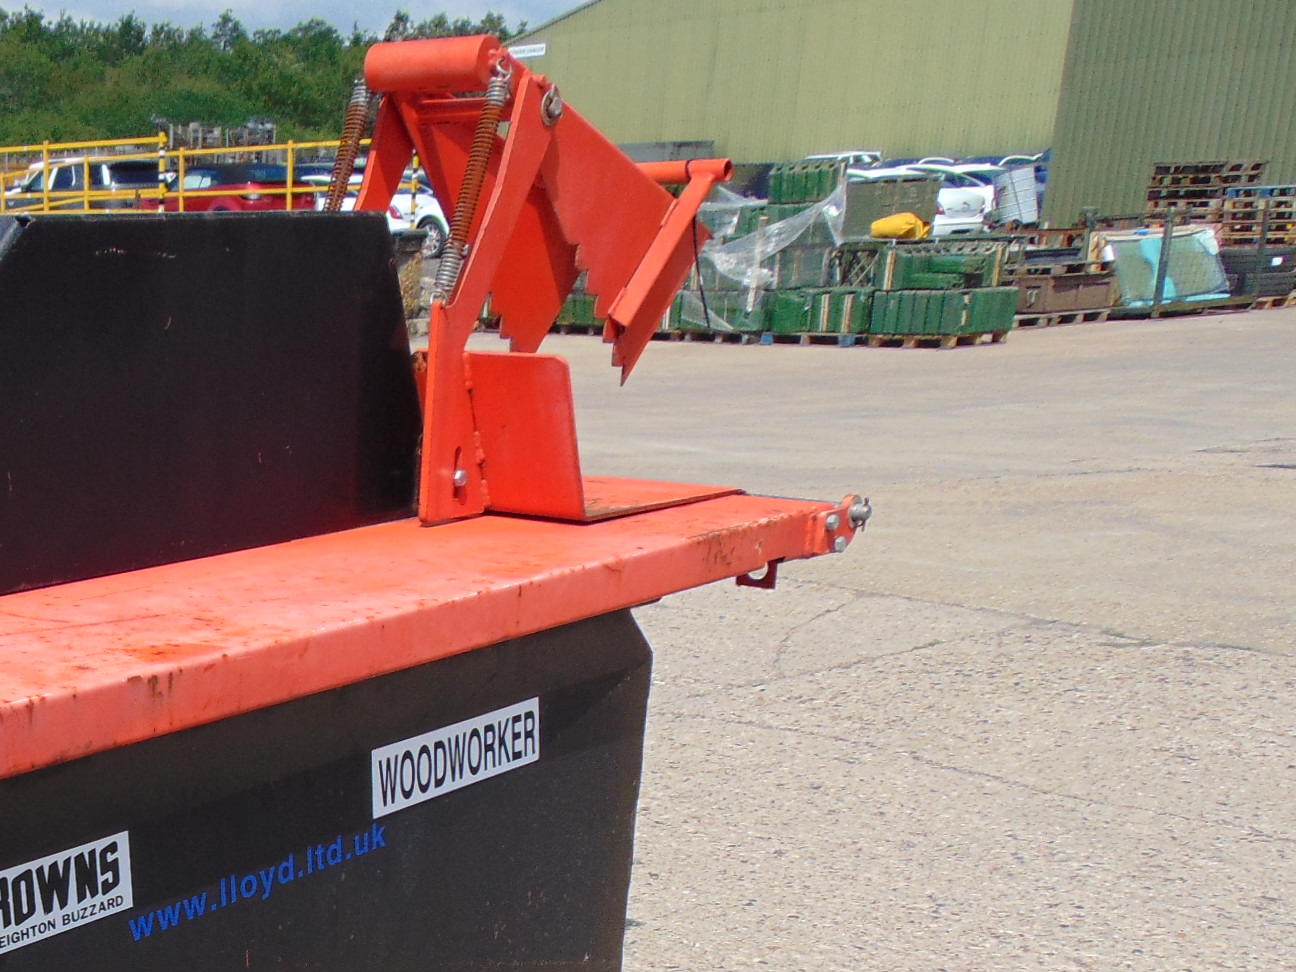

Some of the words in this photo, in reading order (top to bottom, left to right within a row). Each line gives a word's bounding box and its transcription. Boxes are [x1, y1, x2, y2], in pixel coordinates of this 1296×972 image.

[378, 710, 536, 807] WOODWORKER
[61, 895, 124, 927] BUZZARD
[128, 823, 386, 941] www.lloyd.ltd.uk
